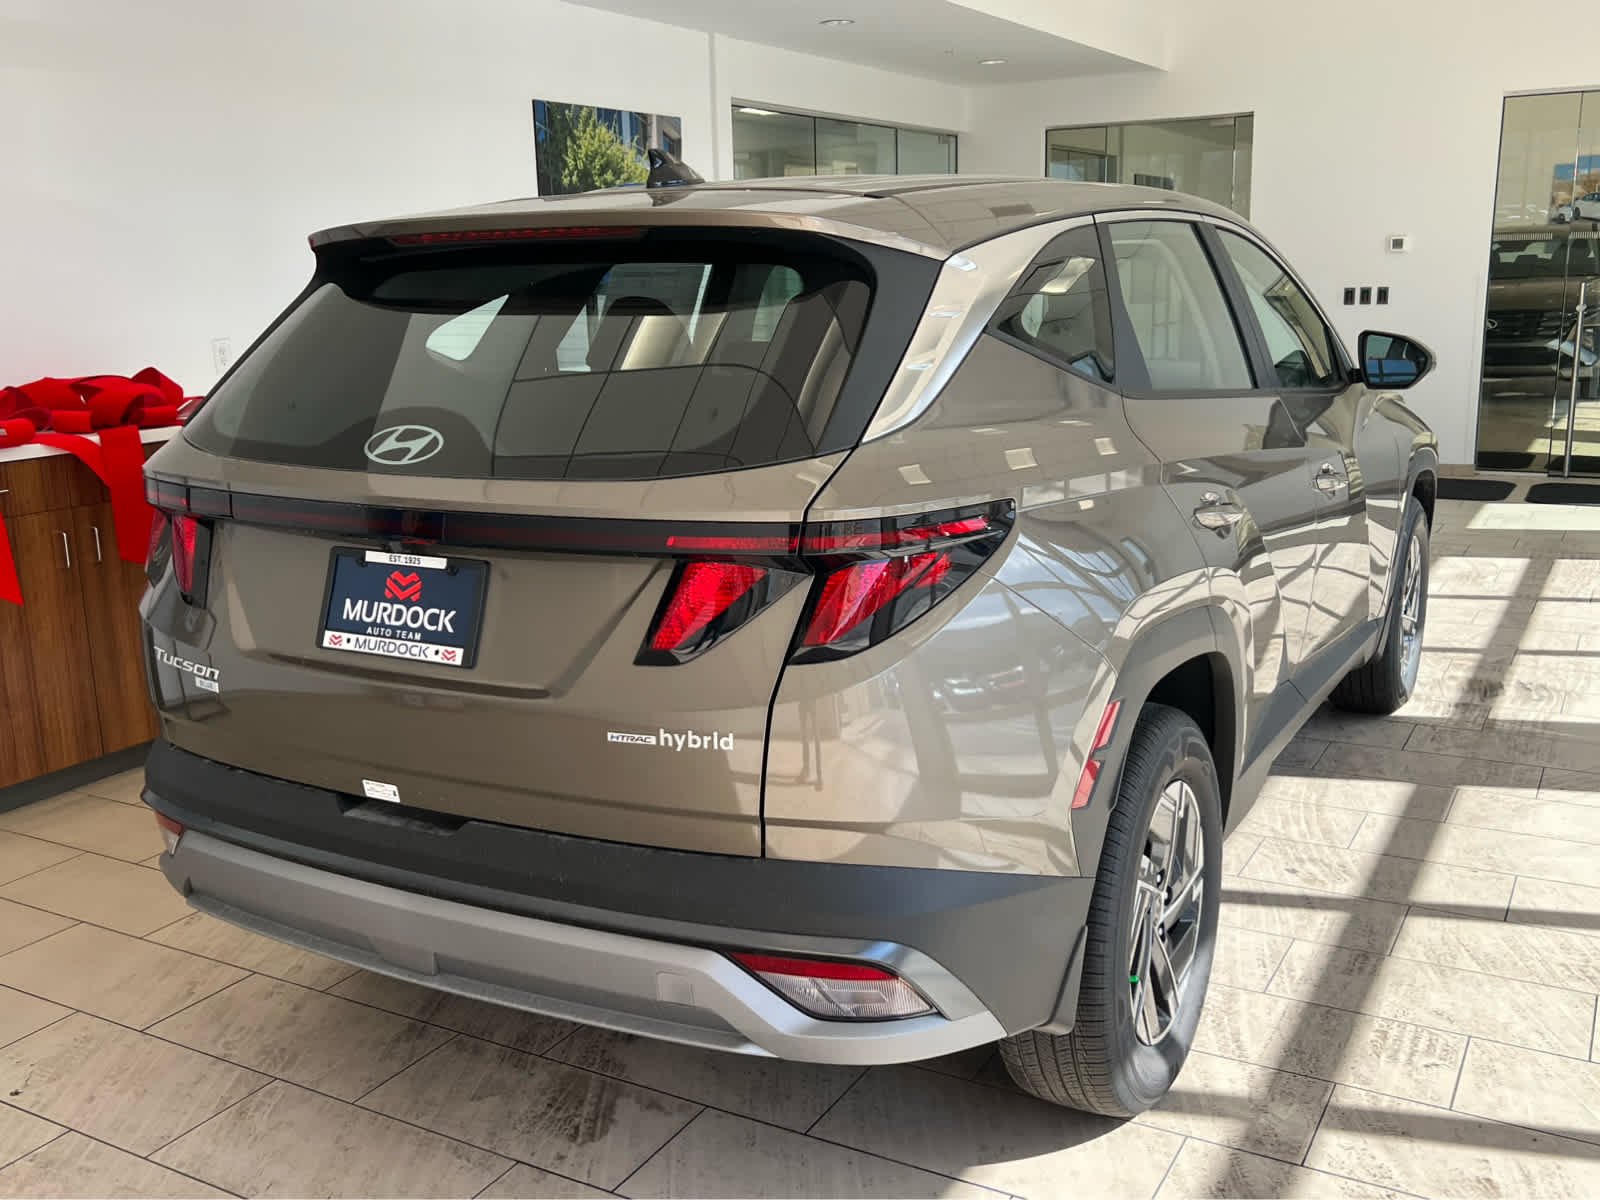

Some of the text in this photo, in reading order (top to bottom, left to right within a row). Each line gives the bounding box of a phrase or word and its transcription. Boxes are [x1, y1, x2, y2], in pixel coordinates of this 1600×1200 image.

[404, 556, 422, 565] 1925
[342, 598, 457, 633] MURDOCK
[366, 626, 422, 641] AUTO TEAM
[354, 636, 430, 659] MURDOCK
[609, 728, 734, 752] HTRAC hybrid
